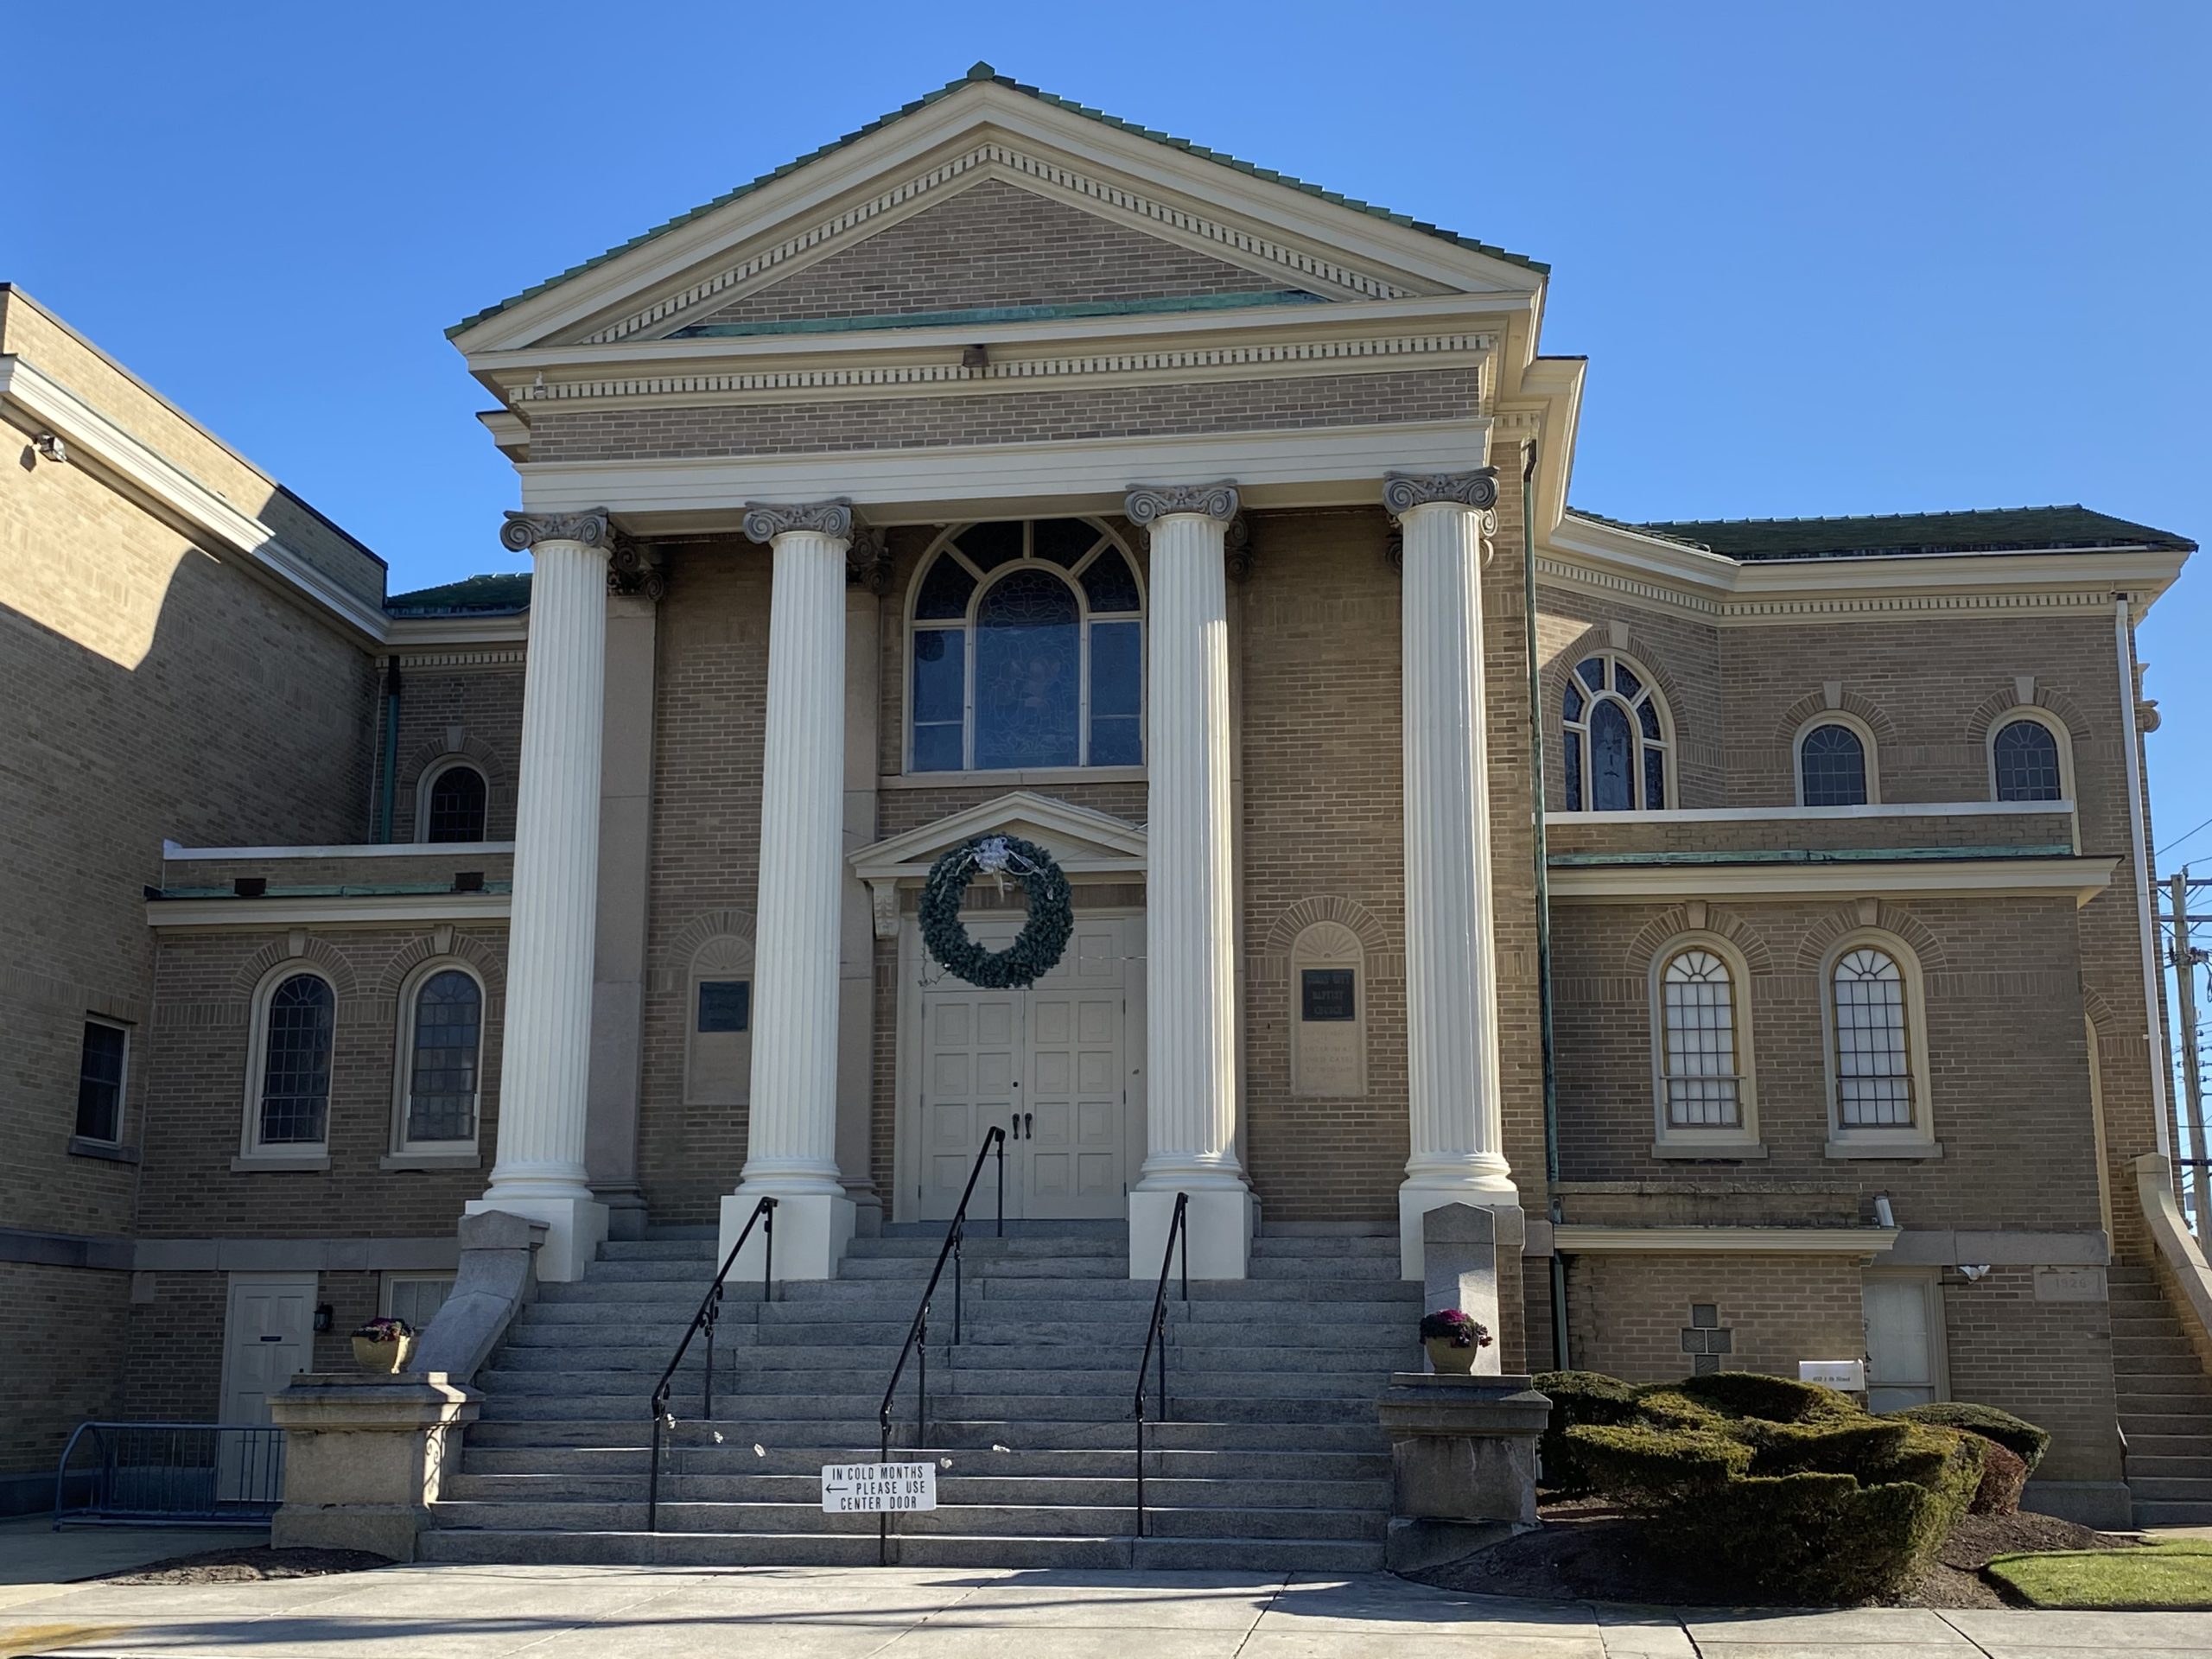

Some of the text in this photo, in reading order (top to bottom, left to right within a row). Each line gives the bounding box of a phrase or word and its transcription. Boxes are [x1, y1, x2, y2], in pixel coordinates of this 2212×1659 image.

[832, 1465, 923, 1481] IN COLD MONTHS
[856, 1480, 925, 1495] PLEASE USE
[840, 1496, 917, 1510] CENTER DOOR
